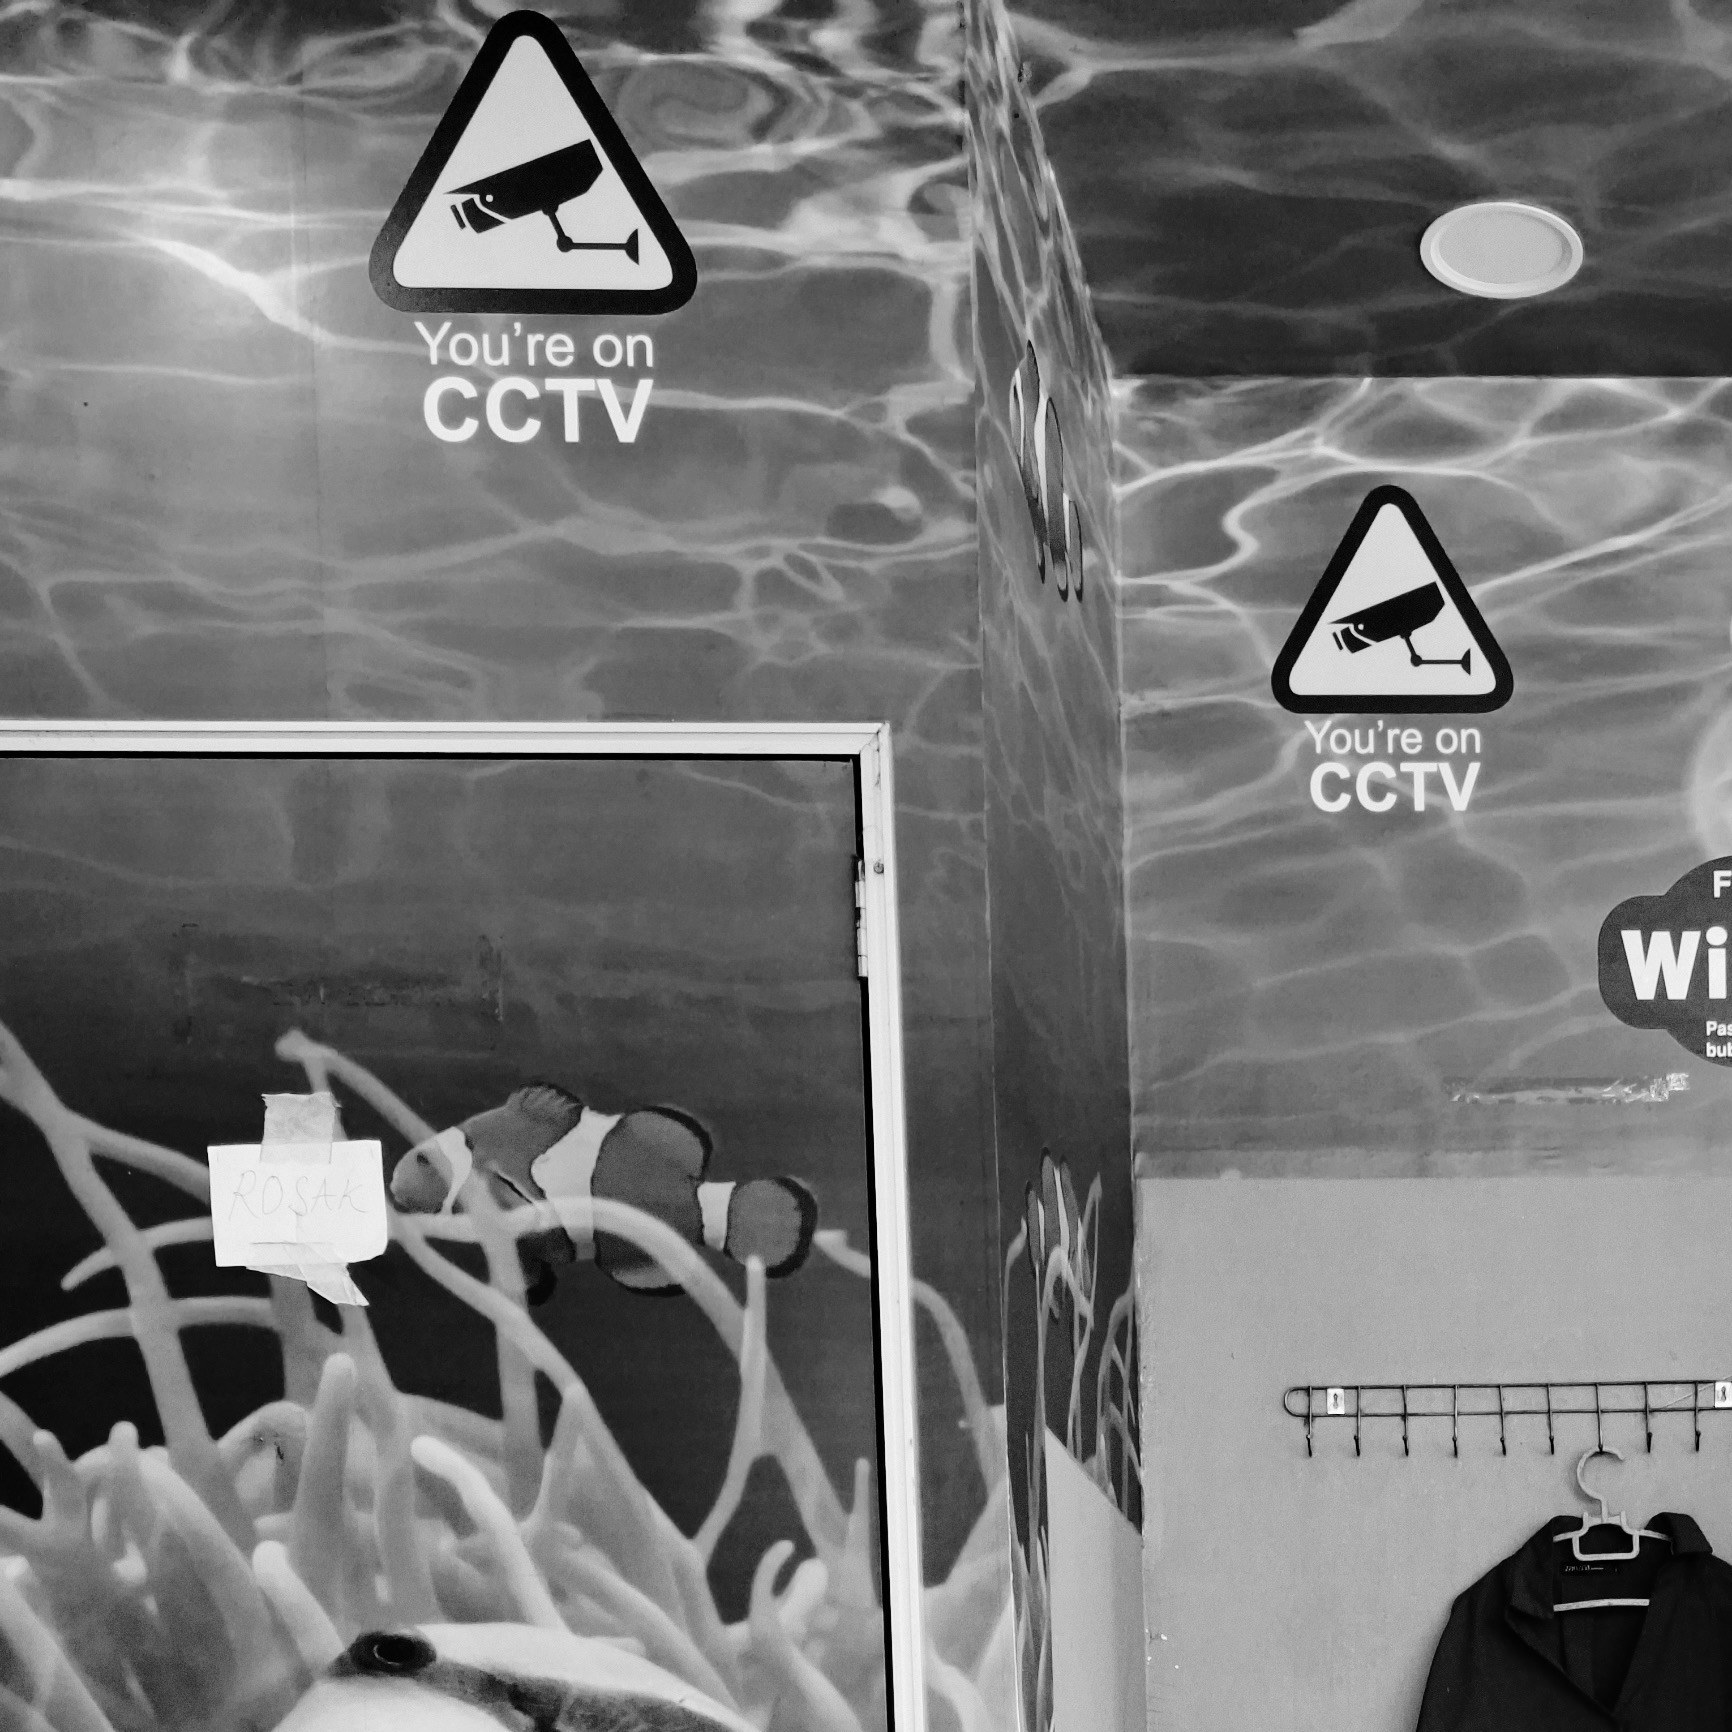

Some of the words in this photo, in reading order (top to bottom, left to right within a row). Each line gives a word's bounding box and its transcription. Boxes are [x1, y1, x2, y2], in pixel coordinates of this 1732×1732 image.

[414, 321, 575, 367] You're
[593, 332, 653, 367] on
[423, 376, 653, 443] CCTV
[1304, 719, 1423, 754] You're
[1436, 728, 1481, 754] on
[1310, 761, 1481, 812] CCTV
[228, 1170, 369, 1221] ROSAK
